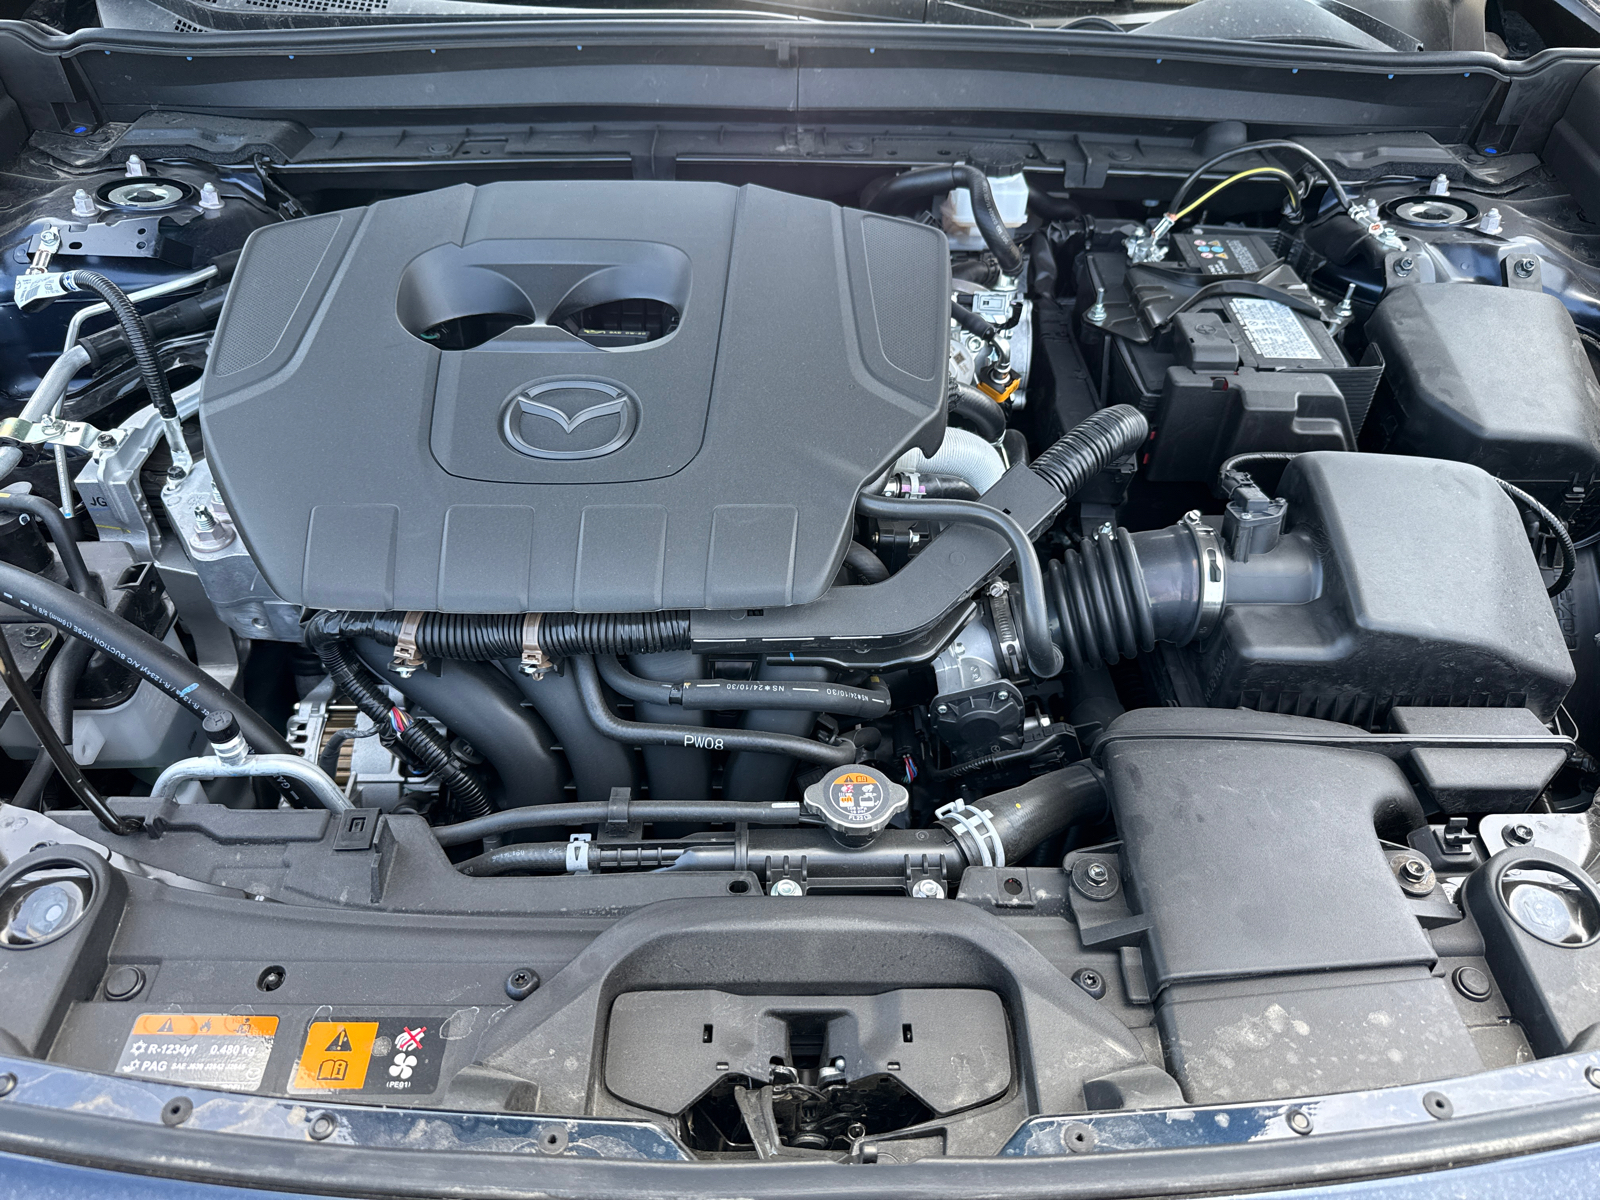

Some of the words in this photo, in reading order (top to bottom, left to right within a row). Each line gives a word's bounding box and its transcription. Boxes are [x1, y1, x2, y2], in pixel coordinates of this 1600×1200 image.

[90, 496, 108, 507] JG
[38, 607, 48, 616] 5/8
[49, 611, 73, 629] (16mm)
[73, 625, 94, 641] HOSE
[93, 637, 127, 660] SUCTION
[127, 657, 141, 668] A/C
[140, 666, 172, 689] R-1234yf
[684, 734, 724, 751] PW08
[147, 1043, 199, 1057] R-1234yf
[209, 1044, 241, 1055] 0.480
[241, 1044, 257, 1057] kg
[140, 1060, 168, 1072] PAG
